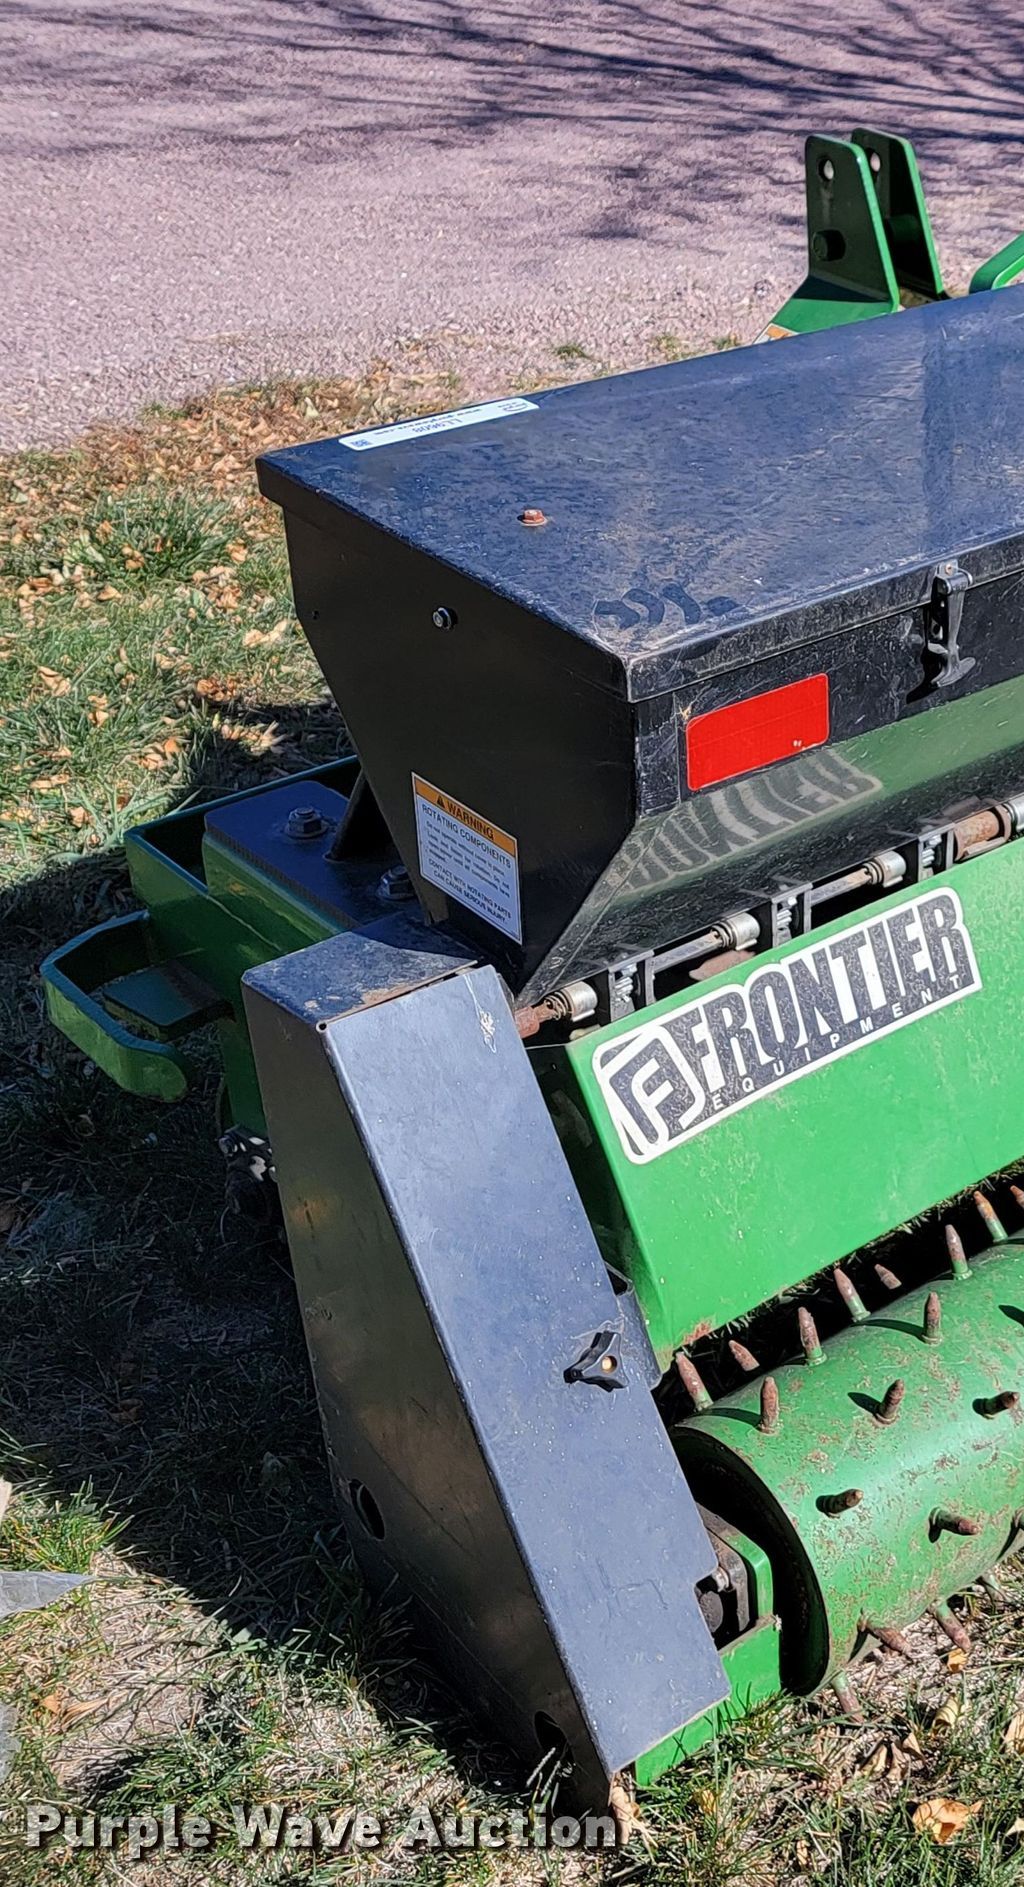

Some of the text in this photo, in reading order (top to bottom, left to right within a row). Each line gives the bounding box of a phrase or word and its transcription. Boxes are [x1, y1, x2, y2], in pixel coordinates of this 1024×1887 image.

[422, 804, 511, 869] ROTATING COMPONENTS
[448, 802, 494, 840] WARNING
[660, 895, 975, 1093] FRONTIER
[711, 974, 963, 1109] EQUIPMENT
